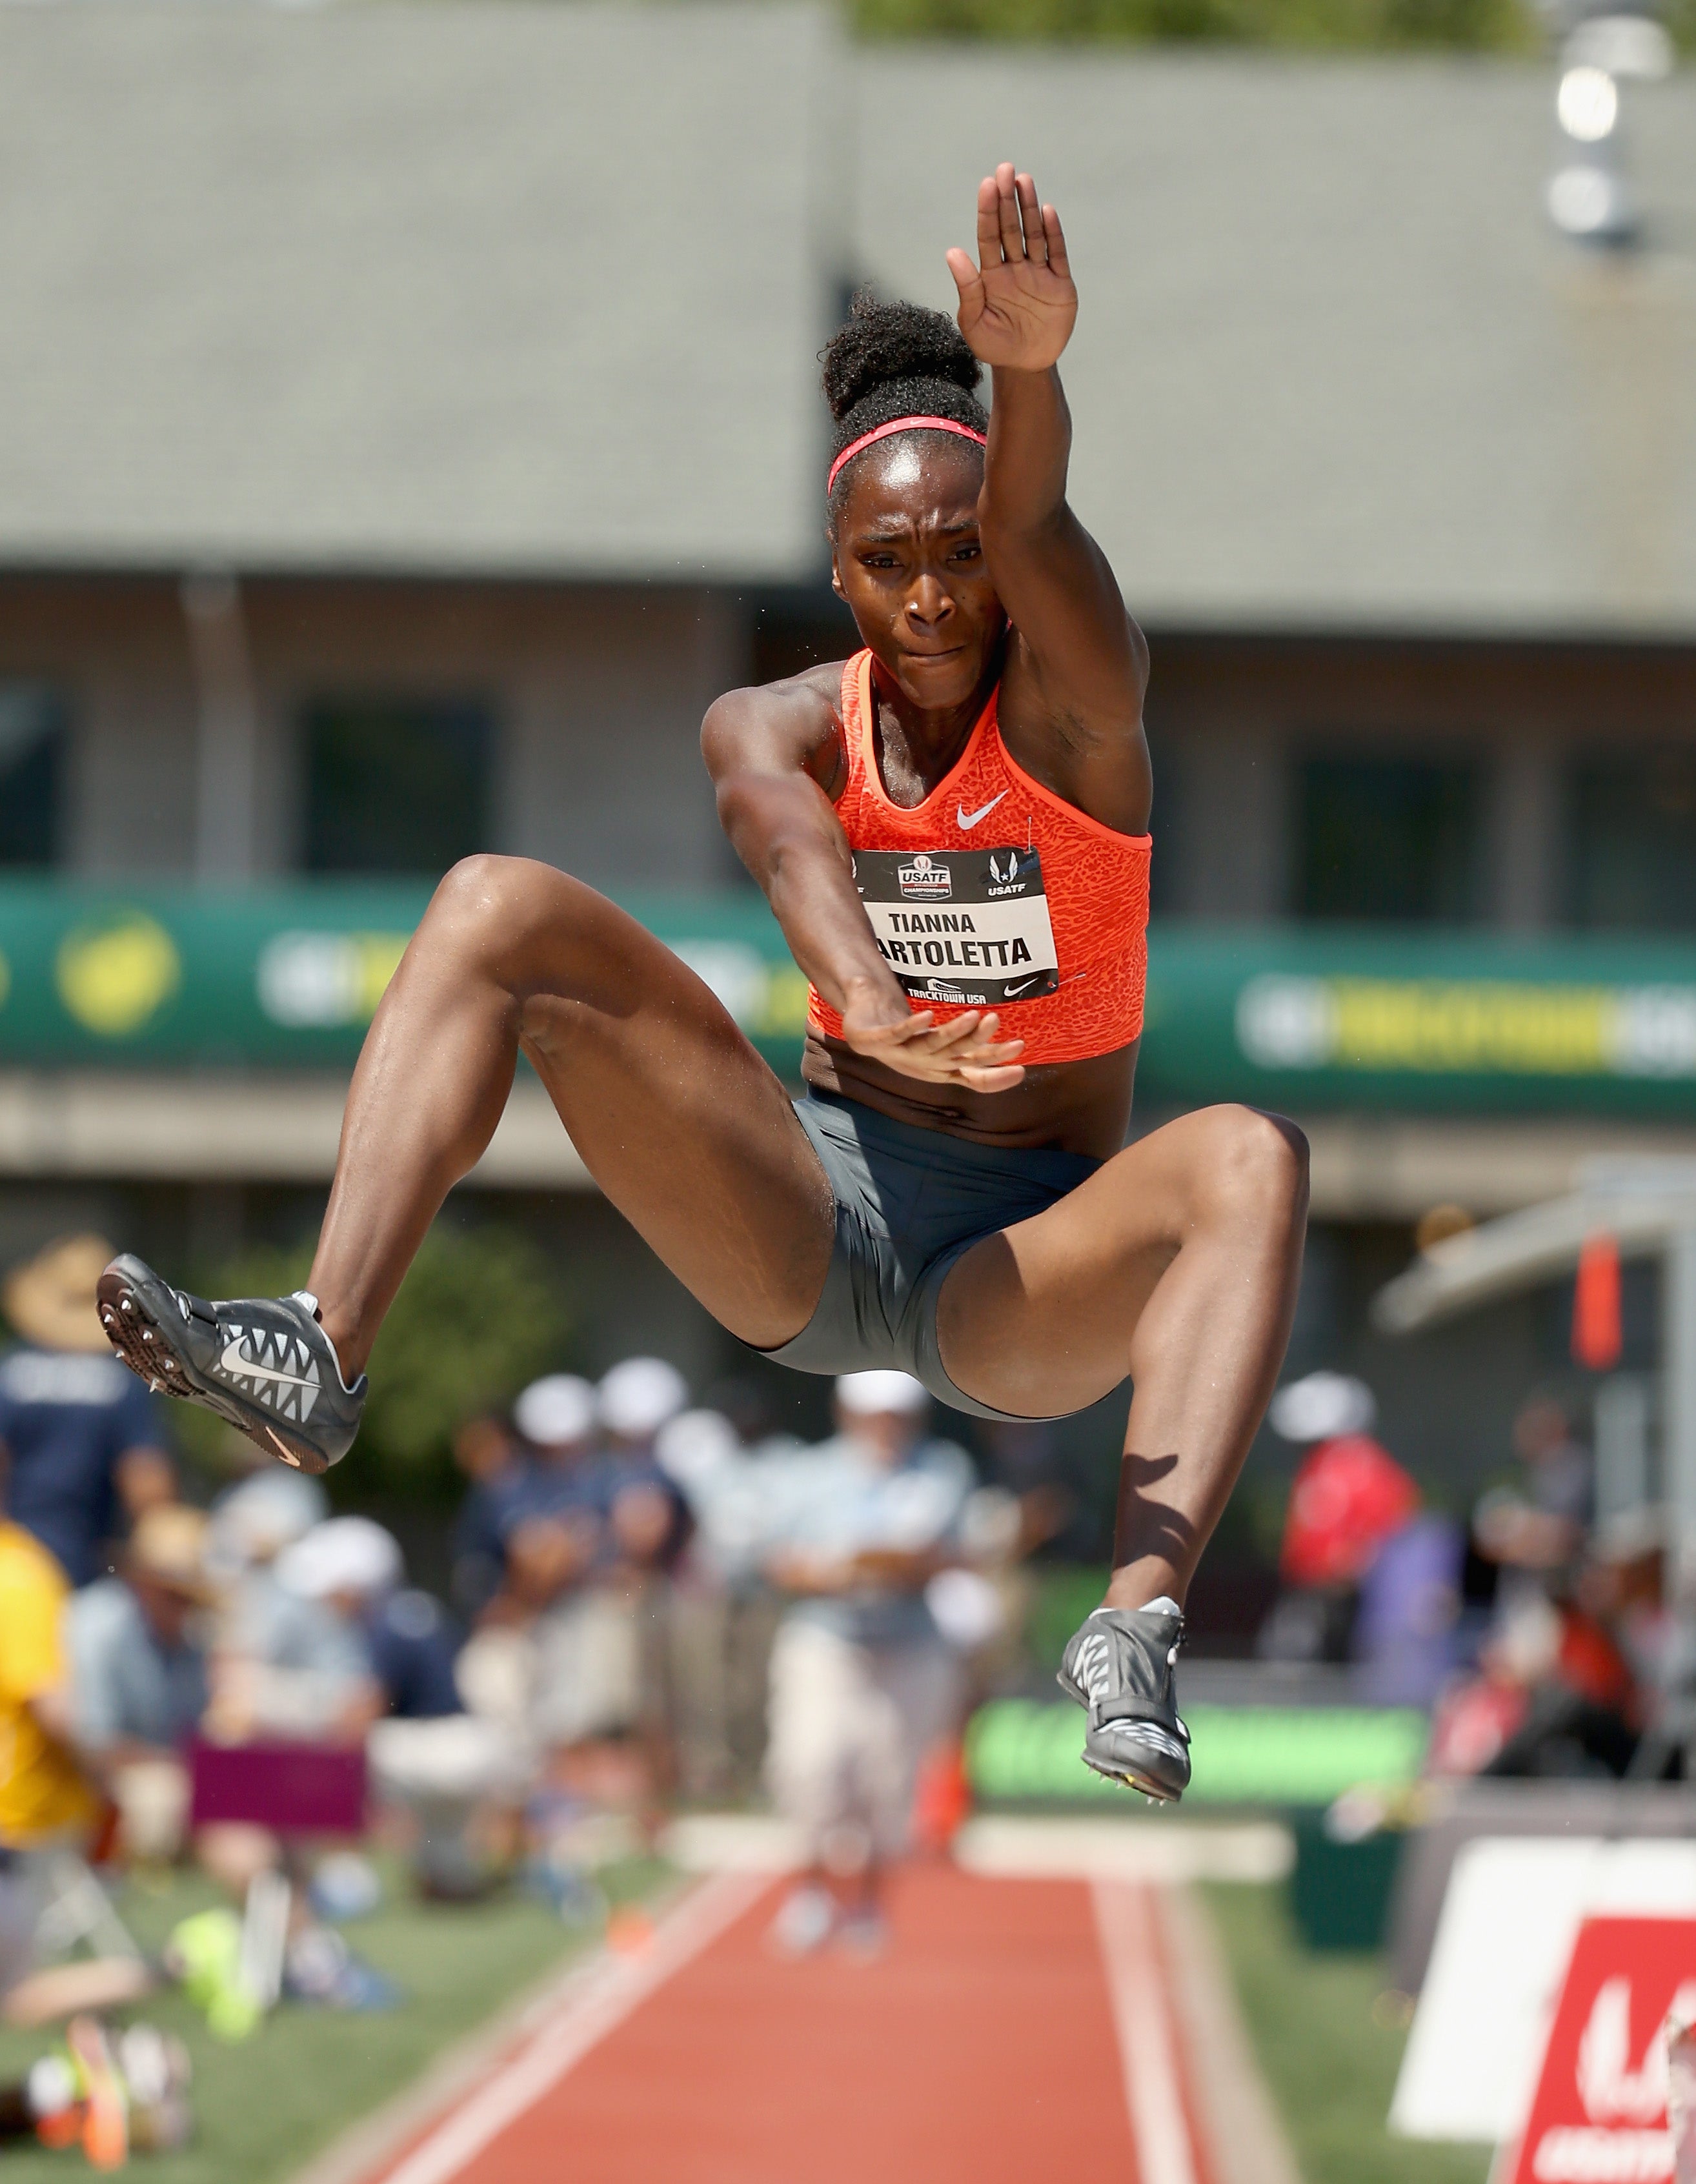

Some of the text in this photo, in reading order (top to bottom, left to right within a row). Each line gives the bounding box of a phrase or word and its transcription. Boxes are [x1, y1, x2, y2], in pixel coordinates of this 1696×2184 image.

[903, 873, 947, 882] USATF
[988, 883, 1027, 896] USATF
[889, 913, 976, 933] TIANNA
[876, 938, 1032, 967] ARTOLETTA
[907, 988, 987, 1004] TRACKTOWN USA
